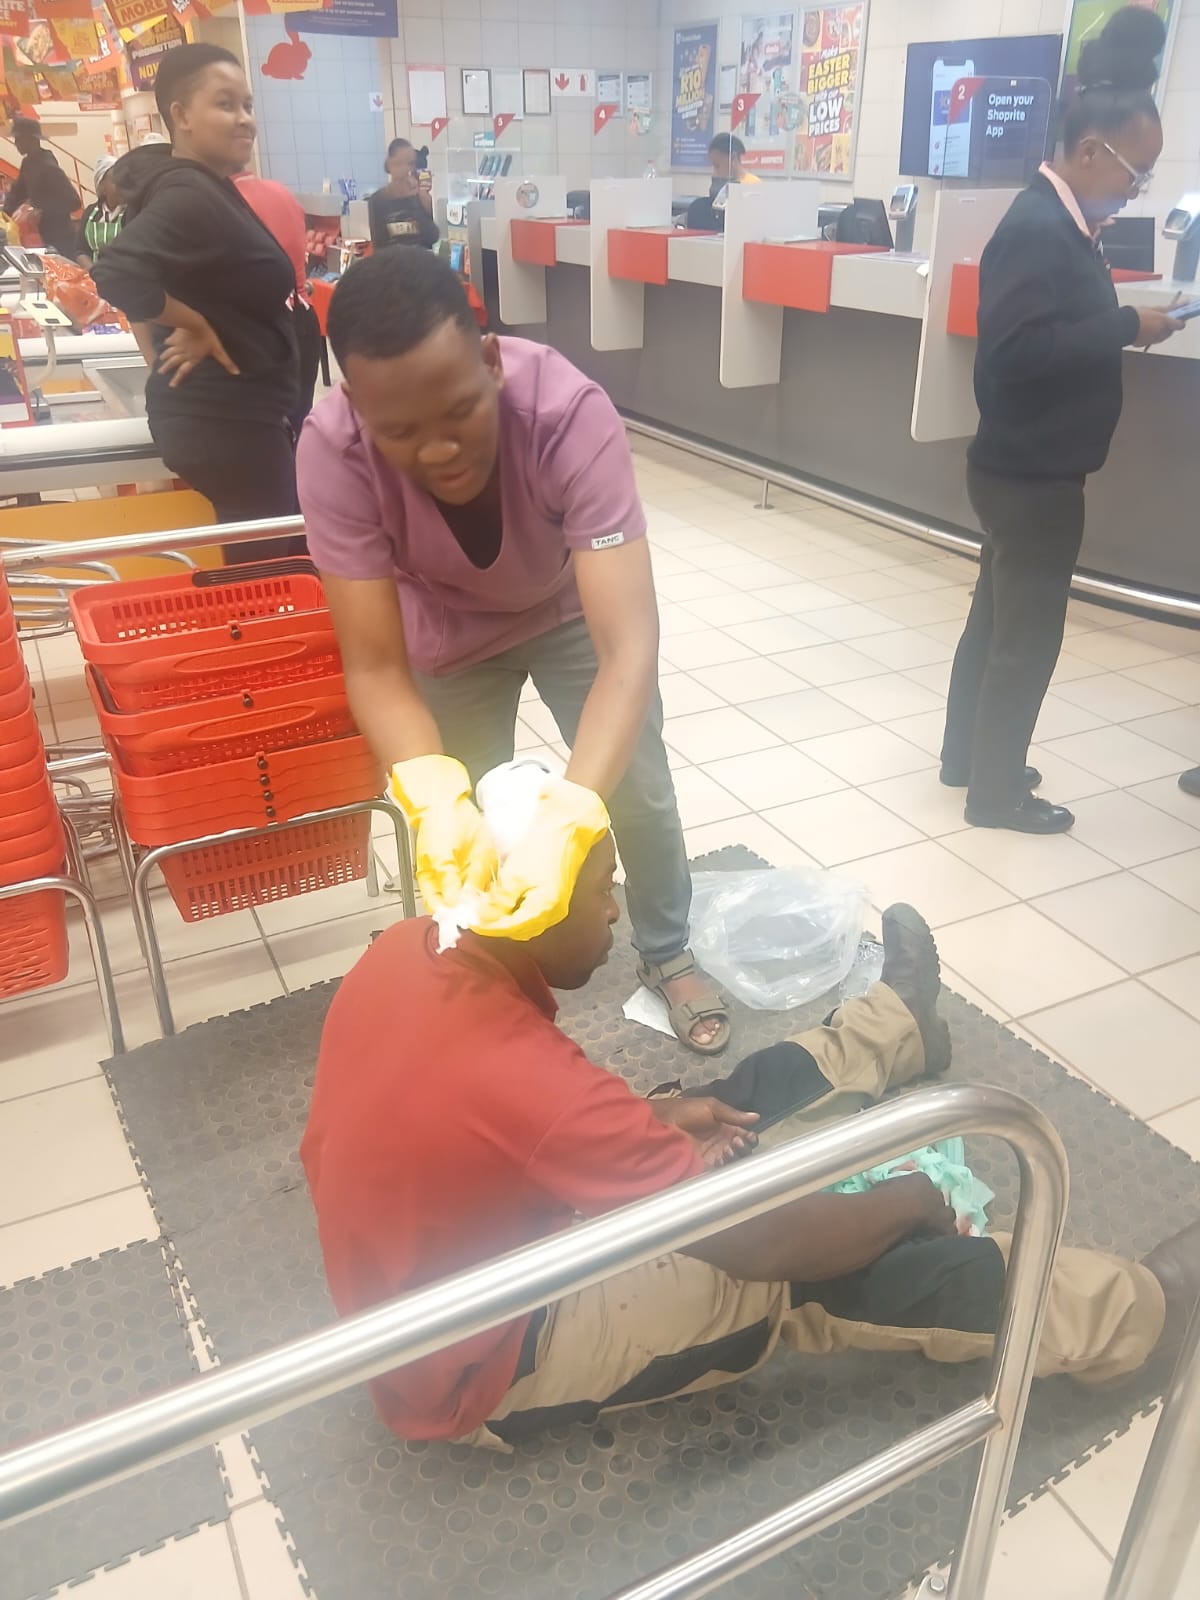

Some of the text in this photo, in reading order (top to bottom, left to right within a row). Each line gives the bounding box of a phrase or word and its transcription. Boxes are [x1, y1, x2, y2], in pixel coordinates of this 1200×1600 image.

[120, 0, 166, 23] MORE
[808, 53, 850, 79] EASTER
[680, 69, 701, 93] R10
[807, 70, 849, 95] BIGGER
[957, 84, 966, 100] 2
[737, 99, 745, 111] 3
[988, 94, 1034, 107] Open your
[599, 109, 606, 119] 4
[809, 97, 843, 123] LOW
[987, 109, 1026, 123] Shoprite
[497, 117, 503, 126] 5
[808, 118, 840, 137] PRICES
[986, 125, 1004, 138] App
